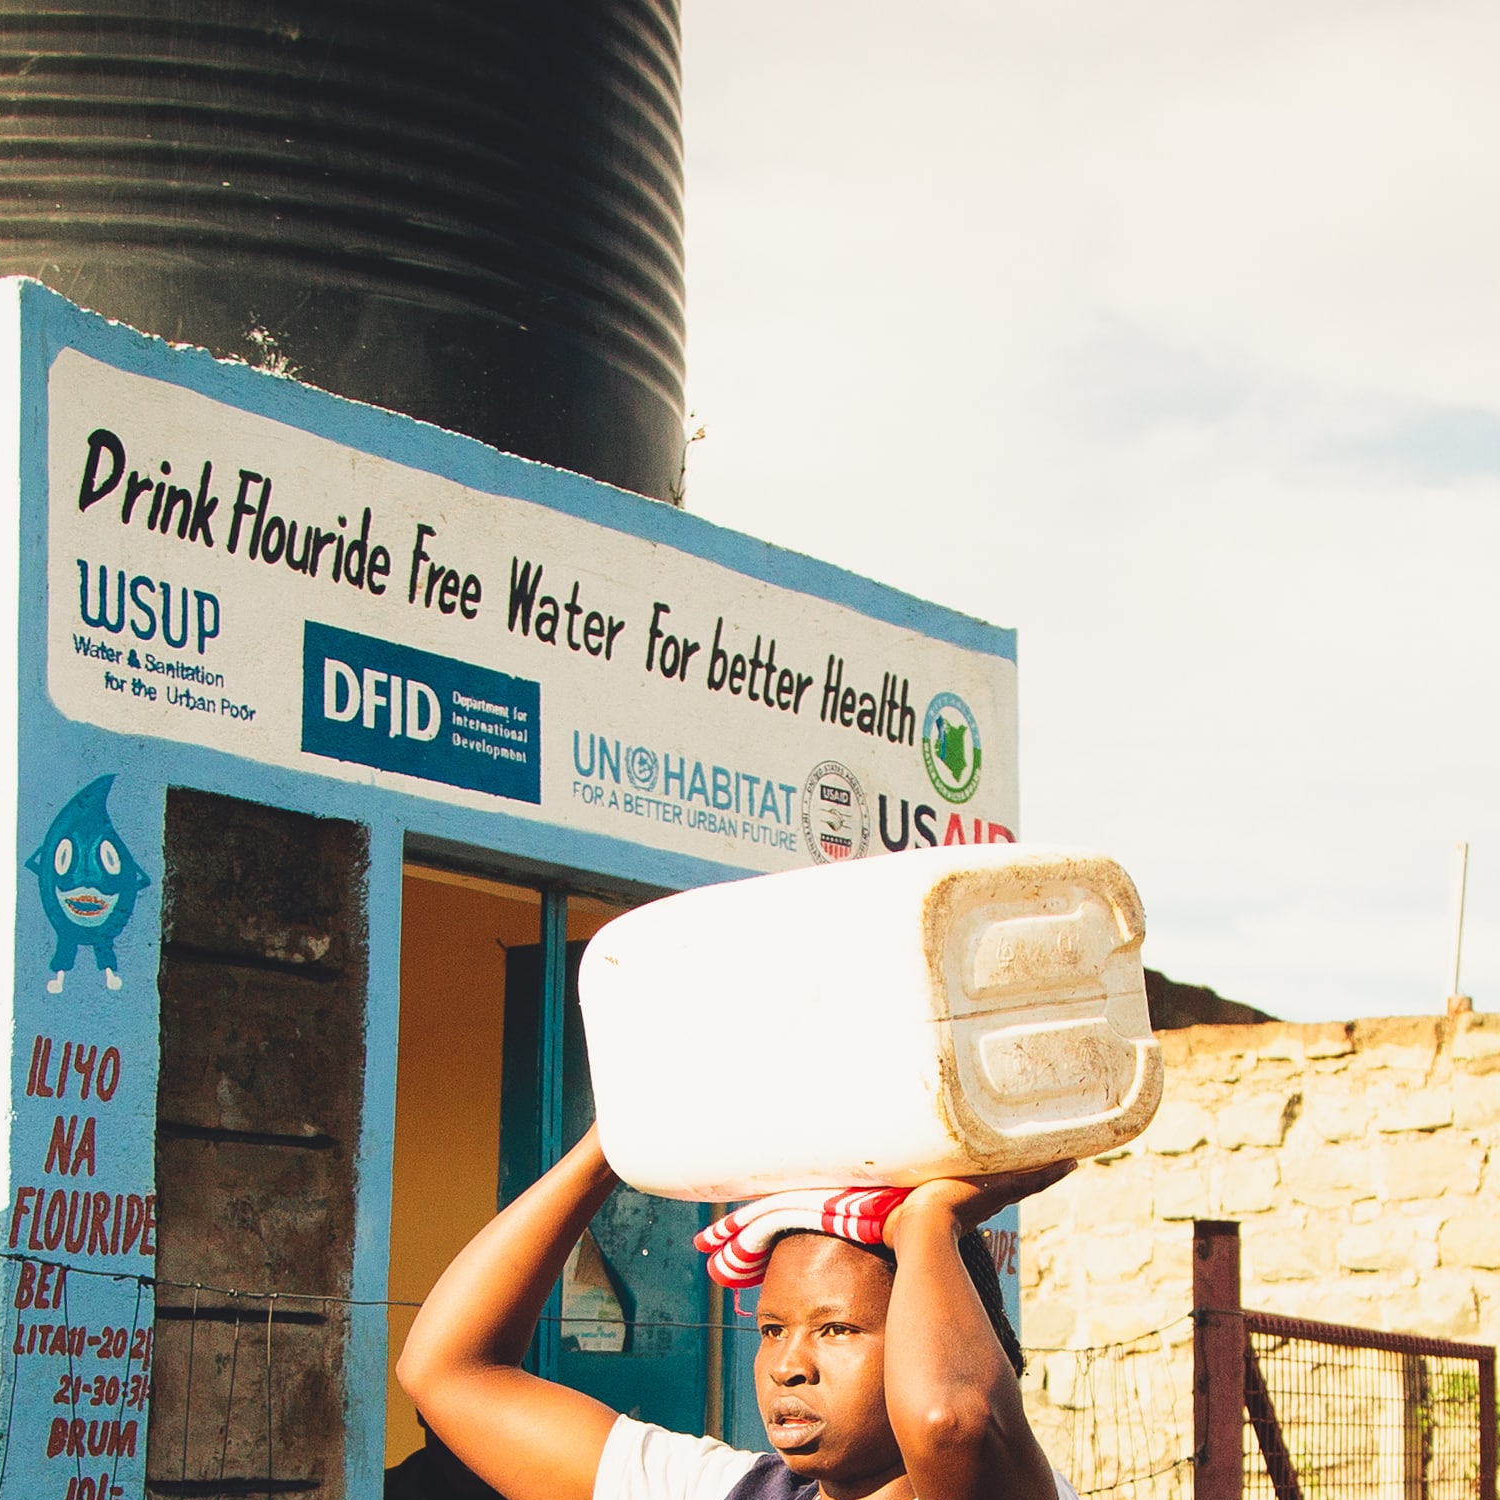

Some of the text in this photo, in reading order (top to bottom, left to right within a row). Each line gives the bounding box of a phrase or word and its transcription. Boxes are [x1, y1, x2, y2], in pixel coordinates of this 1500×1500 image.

[76, 558, 220, 655] WSUP
[78, 428, 220, 548] Drink
[227, 469, 391, 597] Flouride
[408, 523, 482, 620] Free
[507, 556, 625, 660] Water
[645, 602, 700, 682] For
[708, 616, 814, 715] better
[820, 654, 916, 746] Health
[73, 634, 123, 664] Water
[145, 653, 225, 688] Sanitation
[104, 671, 256, 721] for the Urban Poor
[323, 656, 442, 743] DFID
[452, 690, 527, 722] Department for
[452, 711, 528, 743] International
[452, 732, 527, 763] Development
[573, 730, 797, 826] UN HABITAT
[822, 786, 849, 804] USAID
[573, 781, 797, 852] FOR A BETTER URBAN FUTURE
[44, 1115, 96, 1176] NA
[8, 1186, 156, 1256] FLOURIDE
[14, 1261, 64, 1310] BEI
